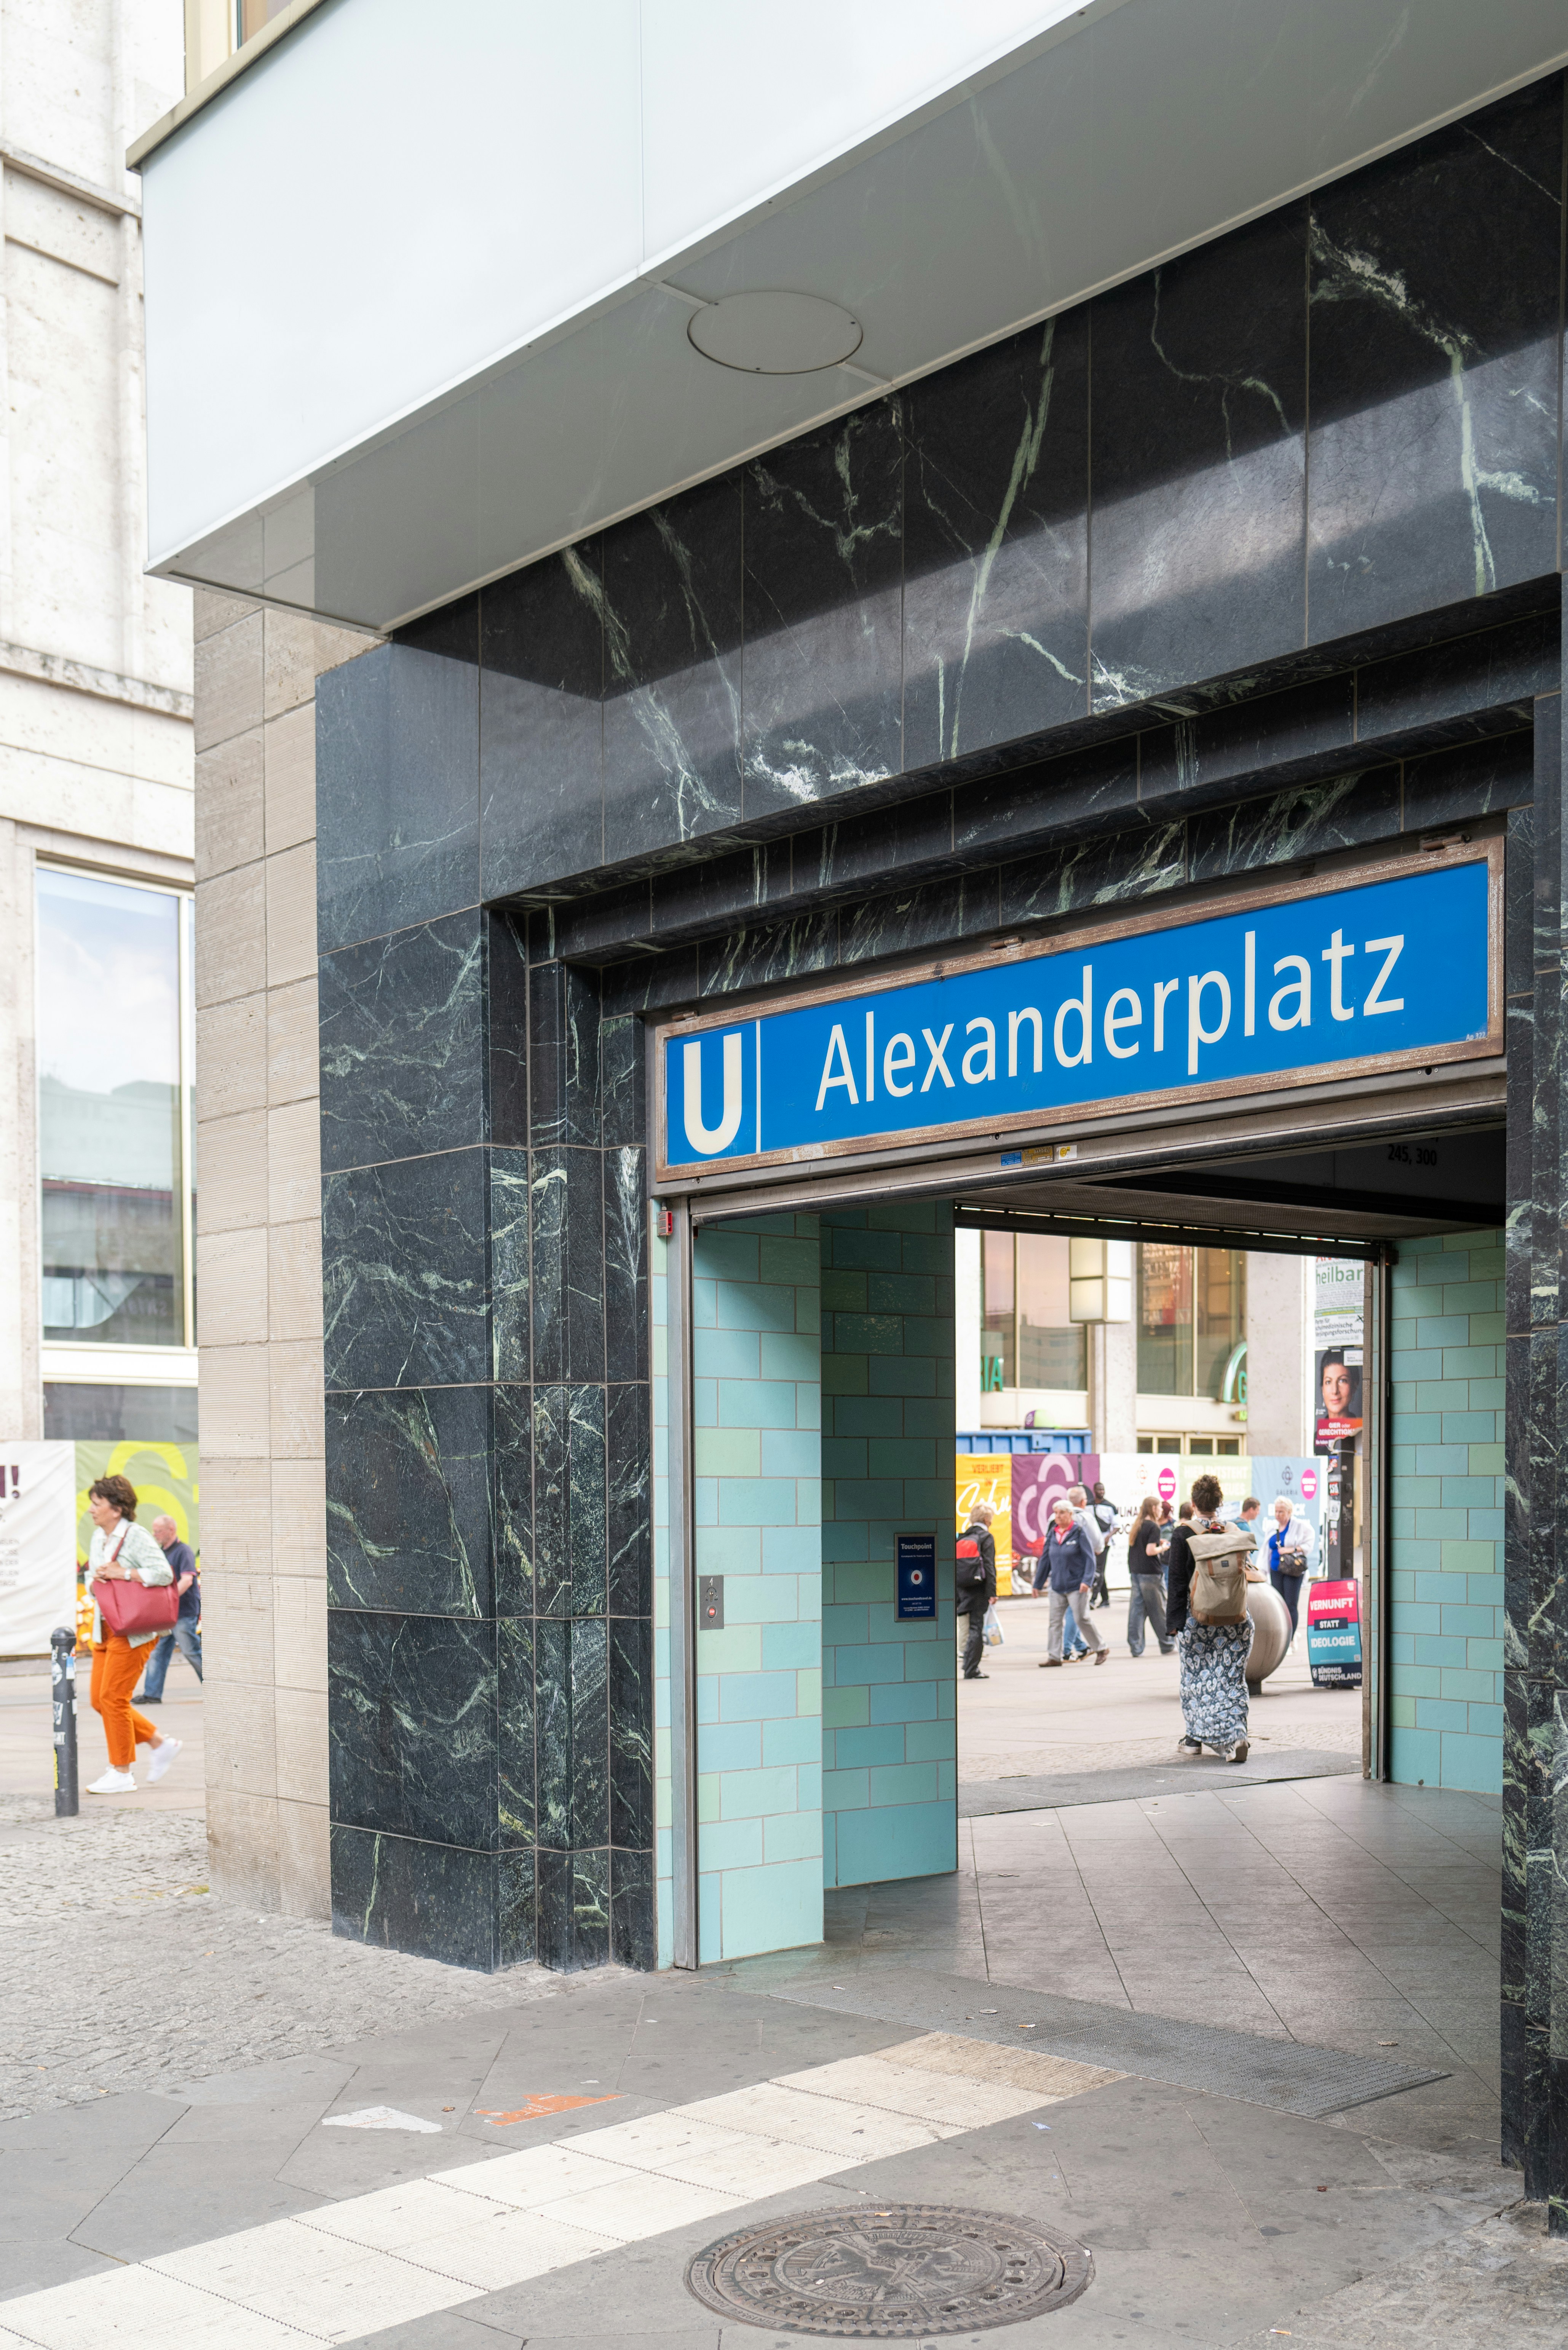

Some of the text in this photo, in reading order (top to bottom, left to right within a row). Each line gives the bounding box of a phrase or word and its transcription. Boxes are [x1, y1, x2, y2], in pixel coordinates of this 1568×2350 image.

[683, 928, 1404, 1154] U Alexanderplatz
[1388, 1144, 1437, 1166] 245, 300
[1316, 1266, 1364, 1285] heilbar
[972, 1464, 1004, 1473] VERLIEBT
[1205, 1465, 1249, 1479] ENTSTEHT
[1310, 1597, 1354, 1611] VERNUNFT
[1319, 1620, 1340, 1629] STATT
[1311, 1636, 1356, 1648] IDEOLOGIE
[1318, 1666, 1342, 1674] BÜNDNIS
[1319, 1673, 1362, 1682] DEUTSCHLAND
[751, 2212, 823, 2231] EISENHAMMER
